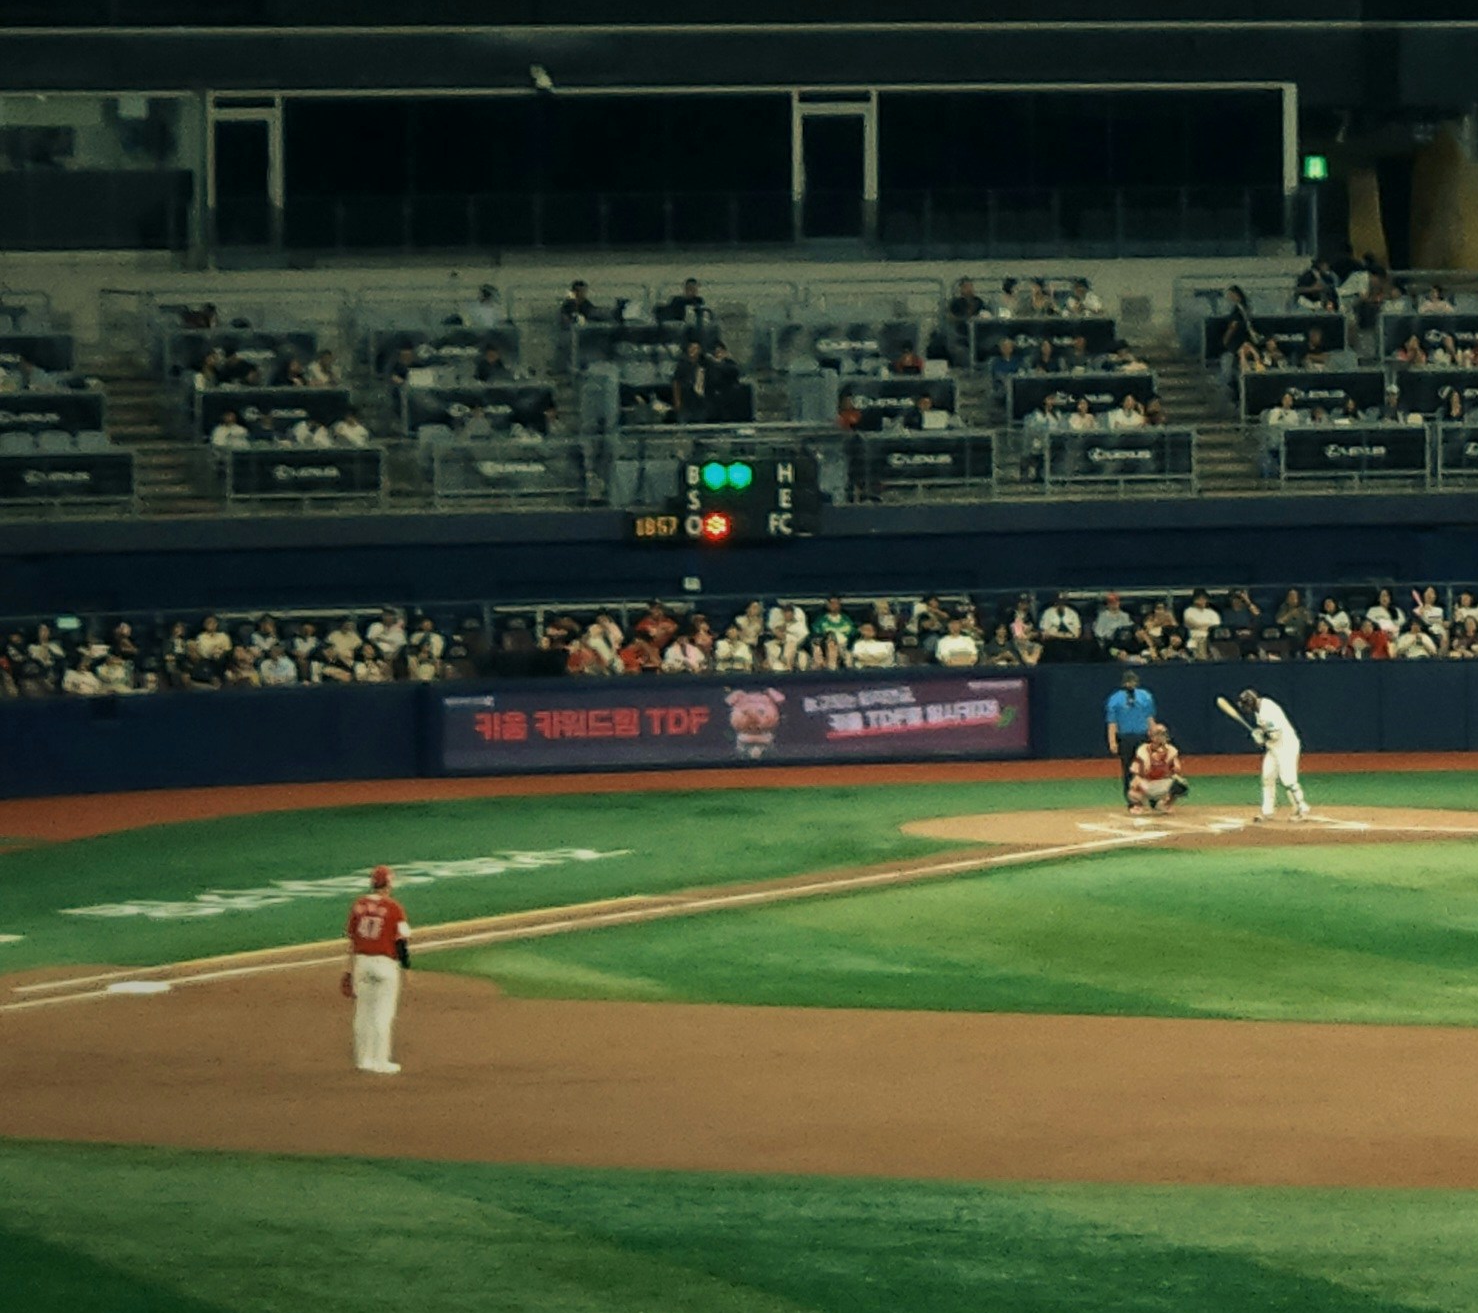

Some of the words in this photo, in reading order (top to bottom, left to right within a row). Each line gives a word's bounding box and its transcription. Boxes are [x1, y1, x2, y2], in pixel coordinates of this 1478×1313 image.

[687, 464, 700, 485] B
[777, 462, 795, 484] H
[687, 489, 702, 511] S
[778, 488, 793, 508] E
[769, 512, 794, 535] FC
[645, 703, 711, 736] TDF
